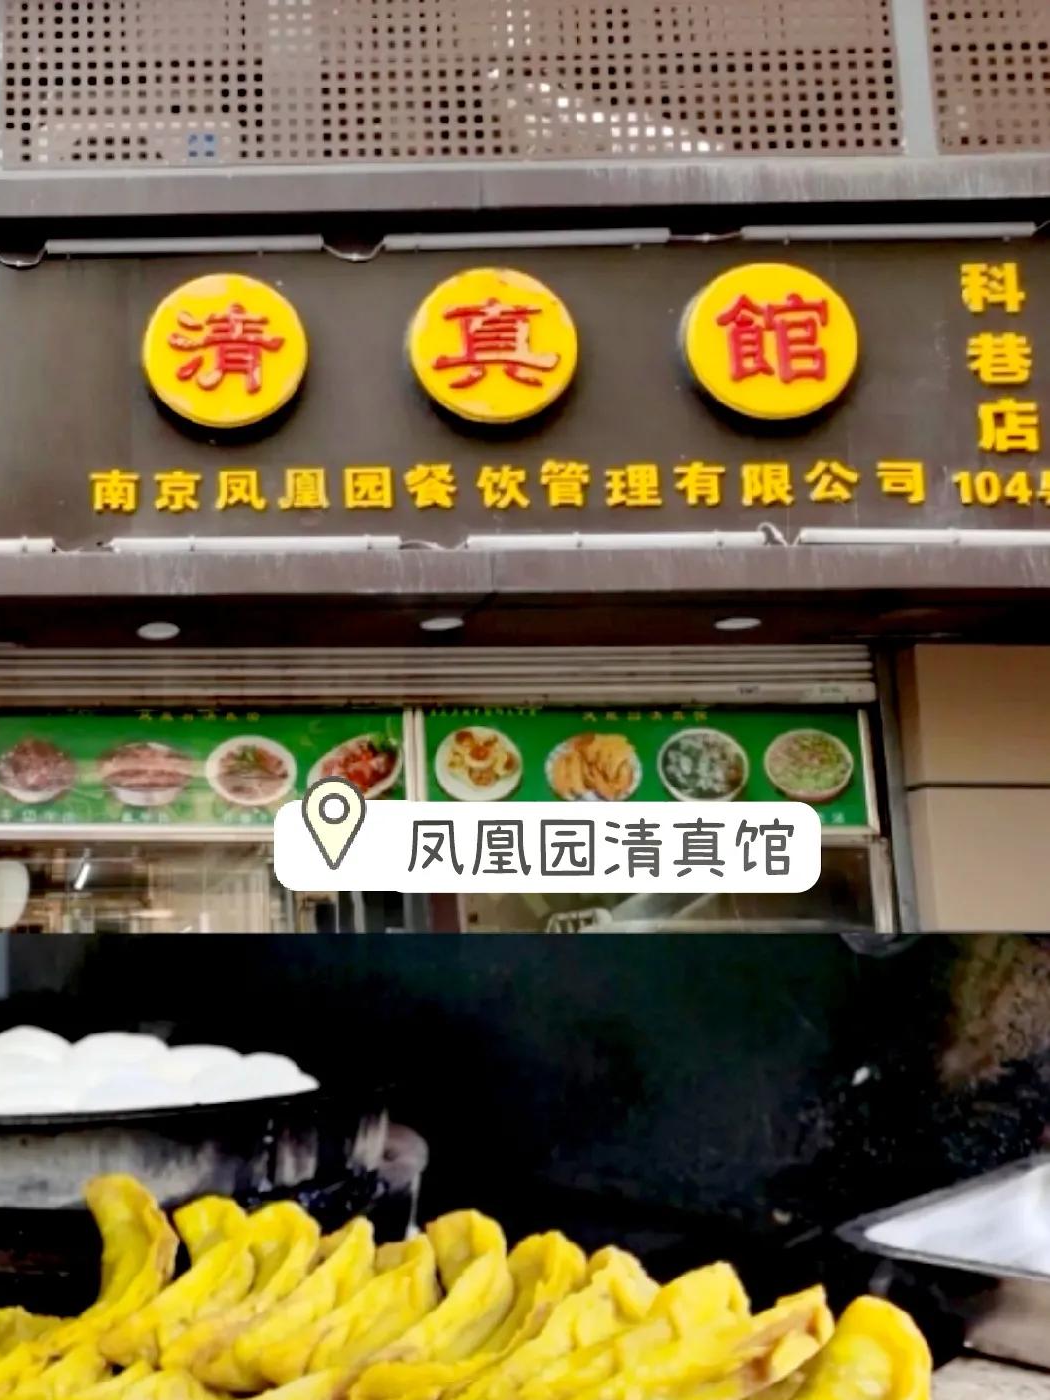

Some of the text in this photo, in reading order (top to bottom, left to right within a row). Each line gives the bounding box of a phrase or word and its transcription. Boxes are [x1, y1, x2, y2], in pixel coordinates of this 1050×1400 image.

[167, 292, 830, 396] 清真館
[960, 262, 1040, 452] 科巷店
[90, 458, 926, 514] 南京凤凰园餐饮管理有限公司
